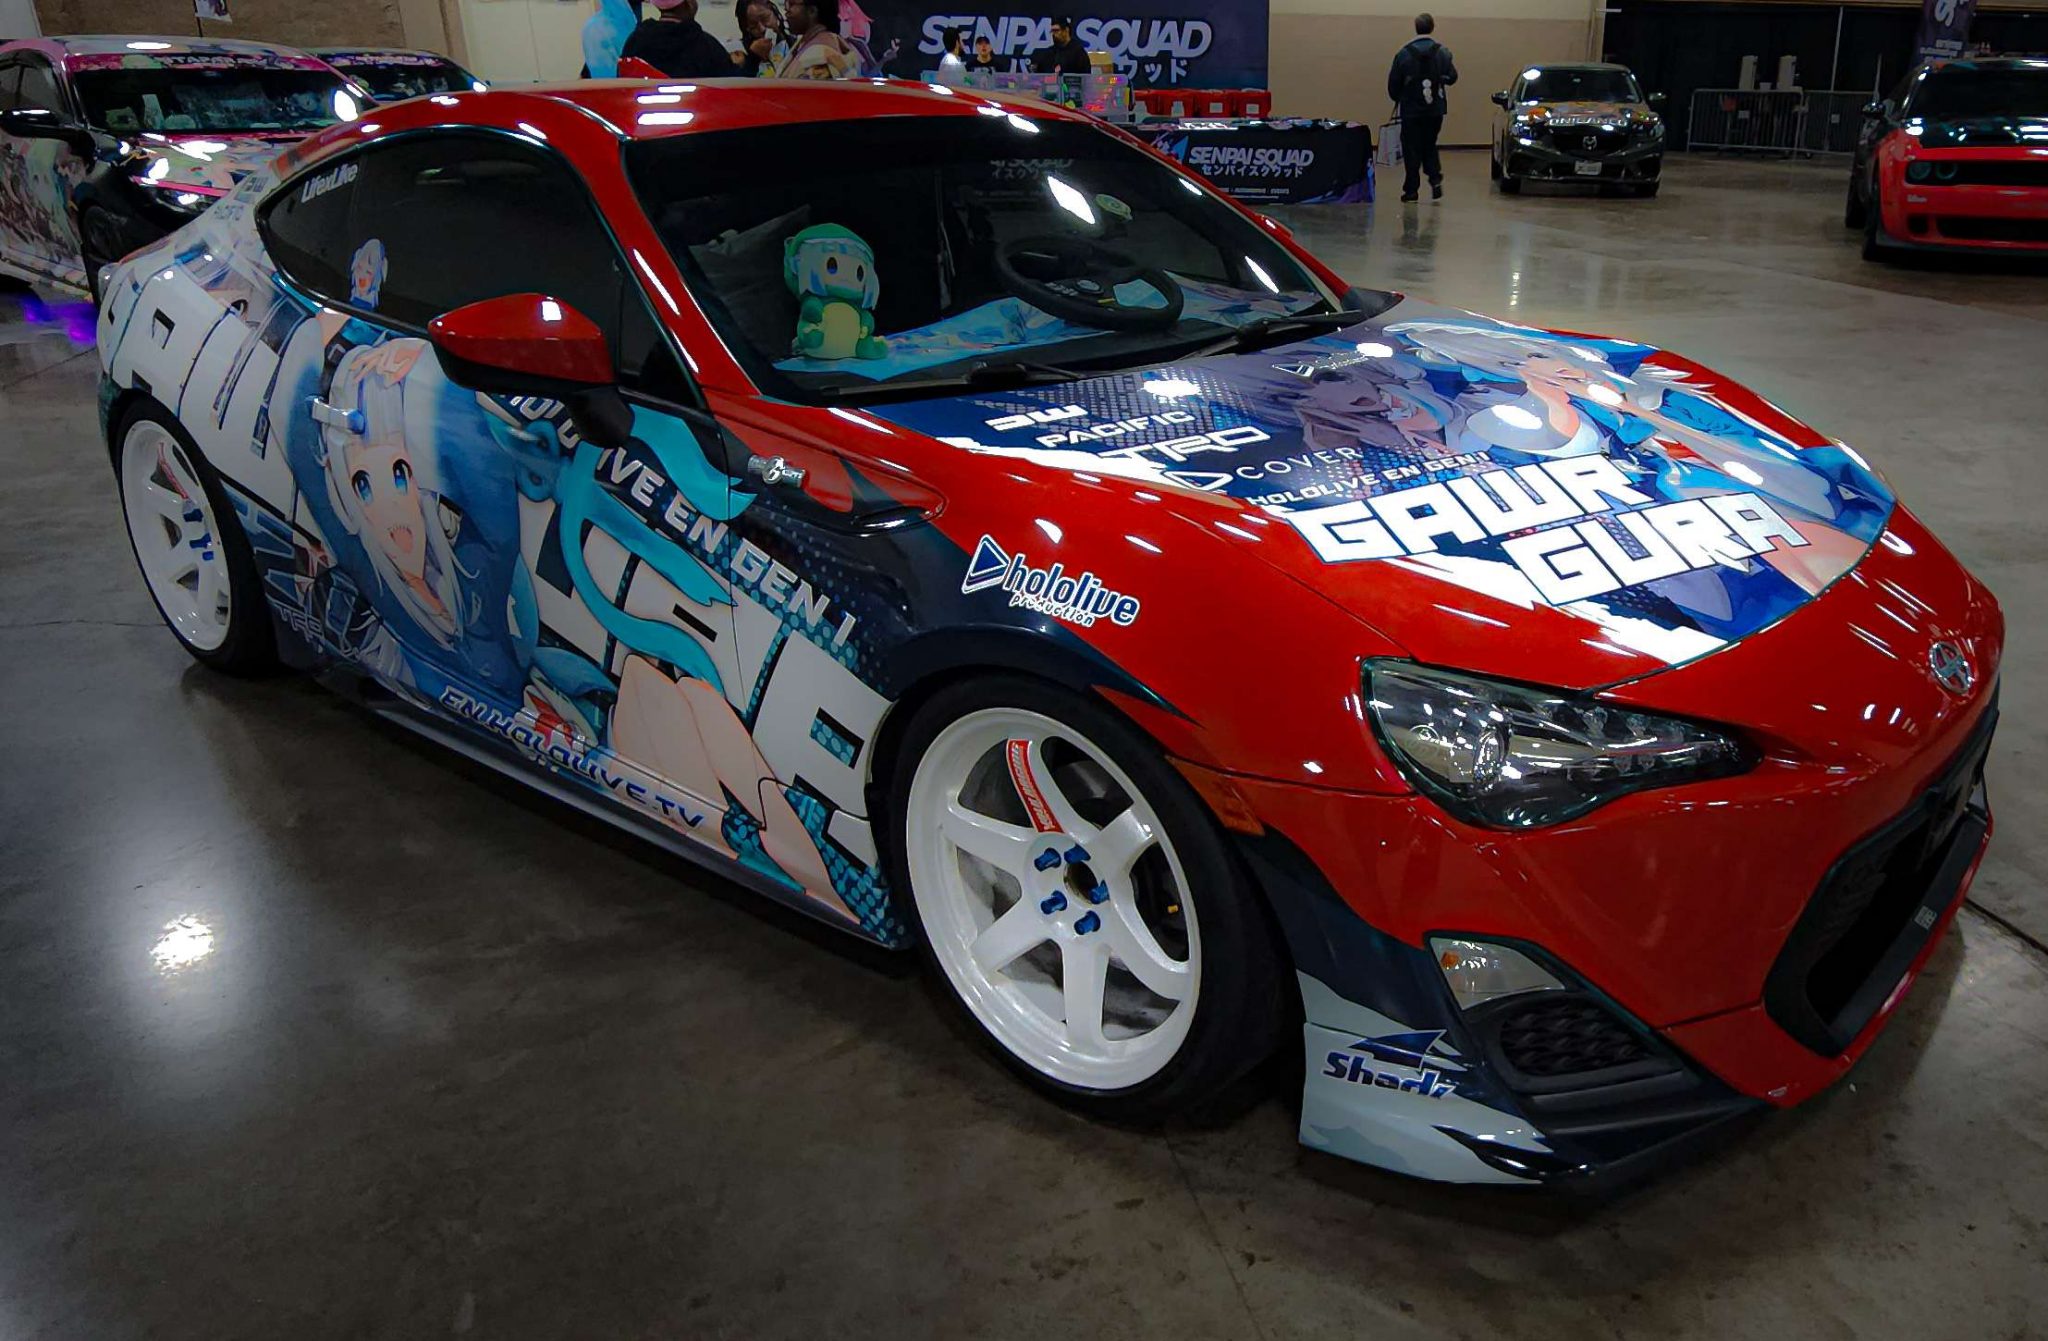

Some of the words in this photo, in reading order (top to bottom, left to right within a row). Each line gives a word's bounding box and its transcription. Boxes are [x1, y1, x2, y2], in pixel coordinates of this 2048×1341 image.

[918, 15, 1071, 55] SENPA
[1075, 18, 1212, 58] SQUAD
[1189, 146, 1252, 164] SENPAI
[1254, 149, 1314, 167] SQUAD
[1036, 411, 1196, 448] PACIFIC
[1236, 446, 1364, 480] COVER
[1247, 472, 1380, 506] HOLOLIVE
[1381, 463, 1422, 482] EN
[1425, 452, 1478, 472] GEN
[1282, 453, 1656, 563] GAWR
[664, 492, 729, 553] EN
[730, 537, 831, 627] GEN
[1499, 492, 1811, 606] GURA
[1001, 552, 1141, 626] hololive
[1009, 591, 1096, 628] production
